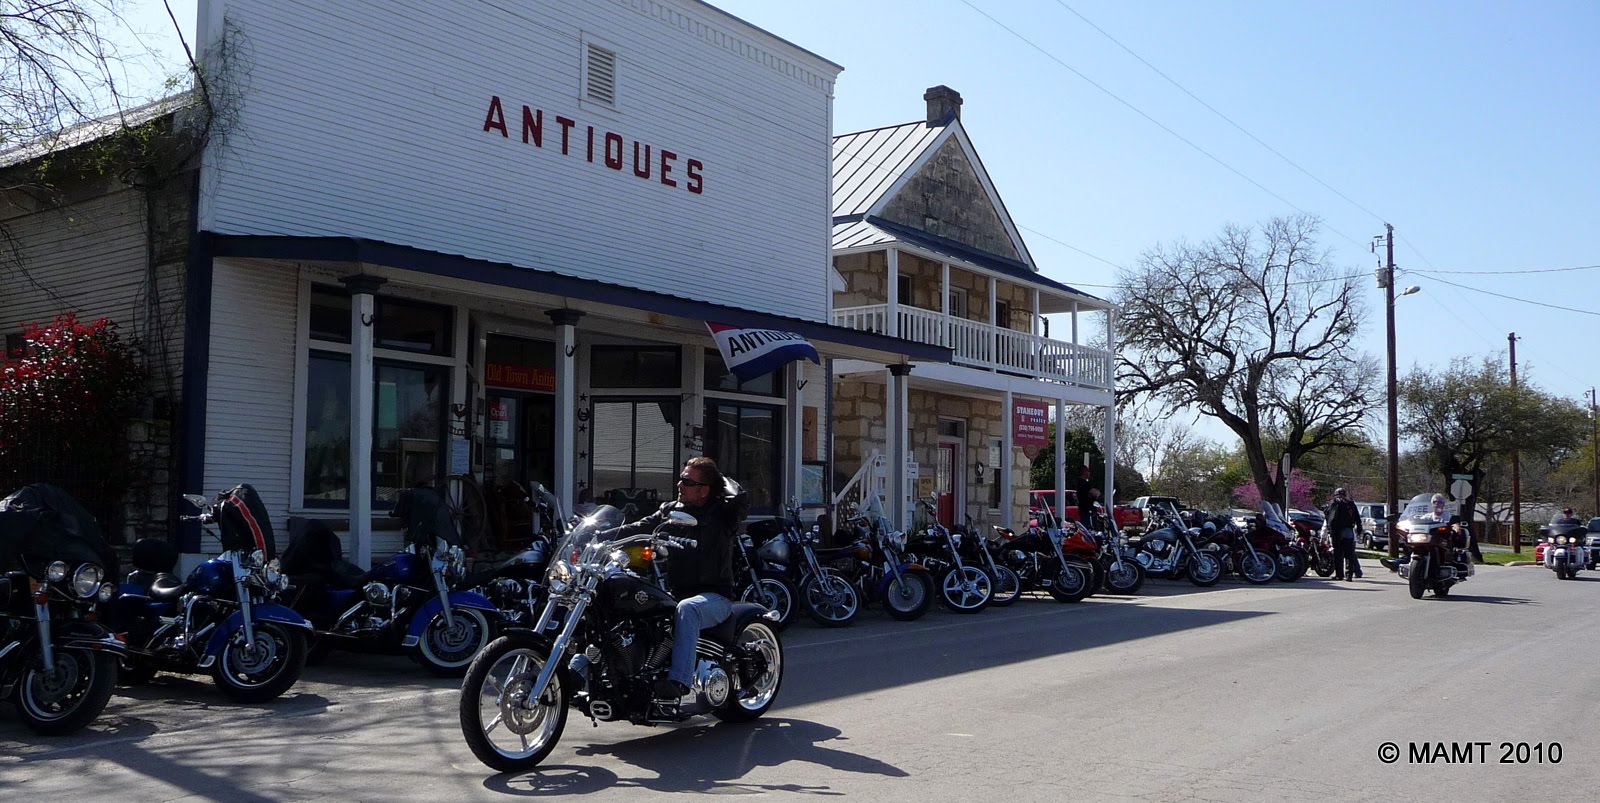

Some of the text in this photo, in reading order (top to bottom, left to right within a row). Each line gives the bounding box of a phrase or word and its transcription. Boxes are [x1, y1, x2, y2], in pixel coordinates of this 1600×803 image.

[483, 95, 703, 194] ANTIQUES
[728, 331, 807, 357] ANTIQUE
[487, 364, 501, 381] Old
[505, 366, 528, 384] Town
